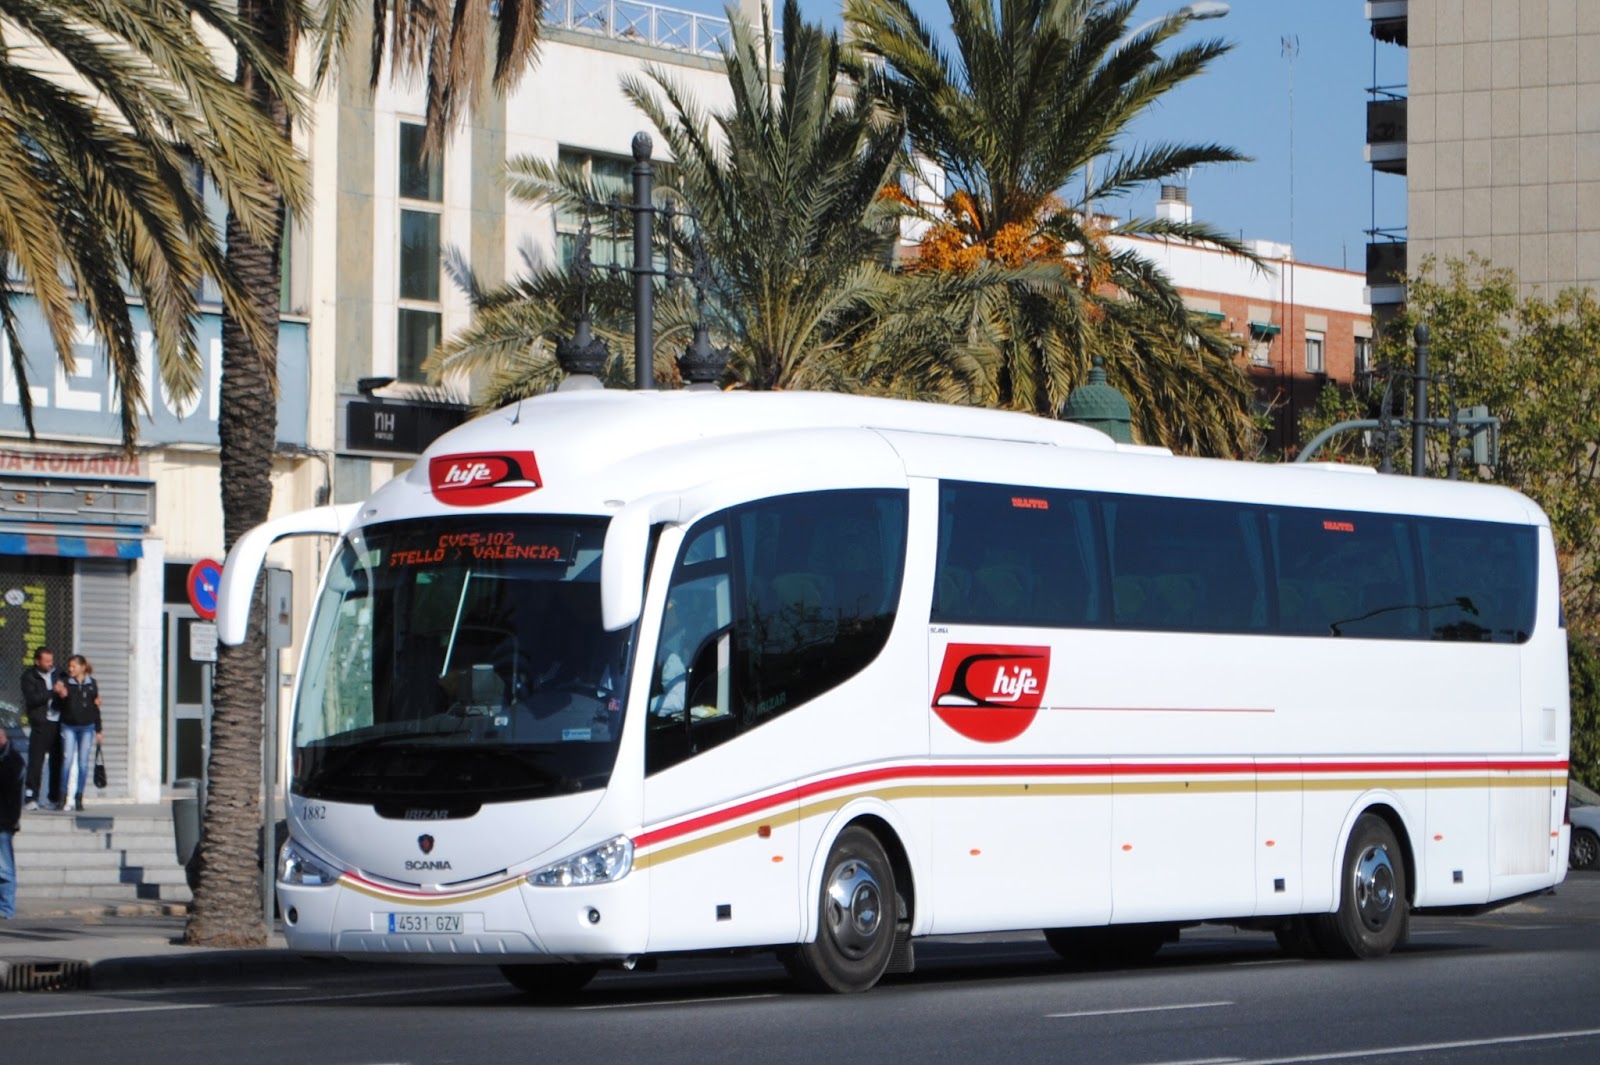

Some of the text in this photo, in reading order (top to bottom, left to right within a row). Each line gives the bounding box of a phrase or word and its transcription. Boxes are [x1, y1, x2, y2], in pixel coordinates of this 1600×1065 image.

[438, 462, 492, 489] hife
[438, 532, 515, 548] CVCS-102
[472, 545, 561, 560] VALENCIA
[985, 665, 1040, 702] hife
[302, 805, 327, 820] 1882
[404, 860, 453, 871] SCANIA
[399, 916, 461, 931] 4531 GZV
